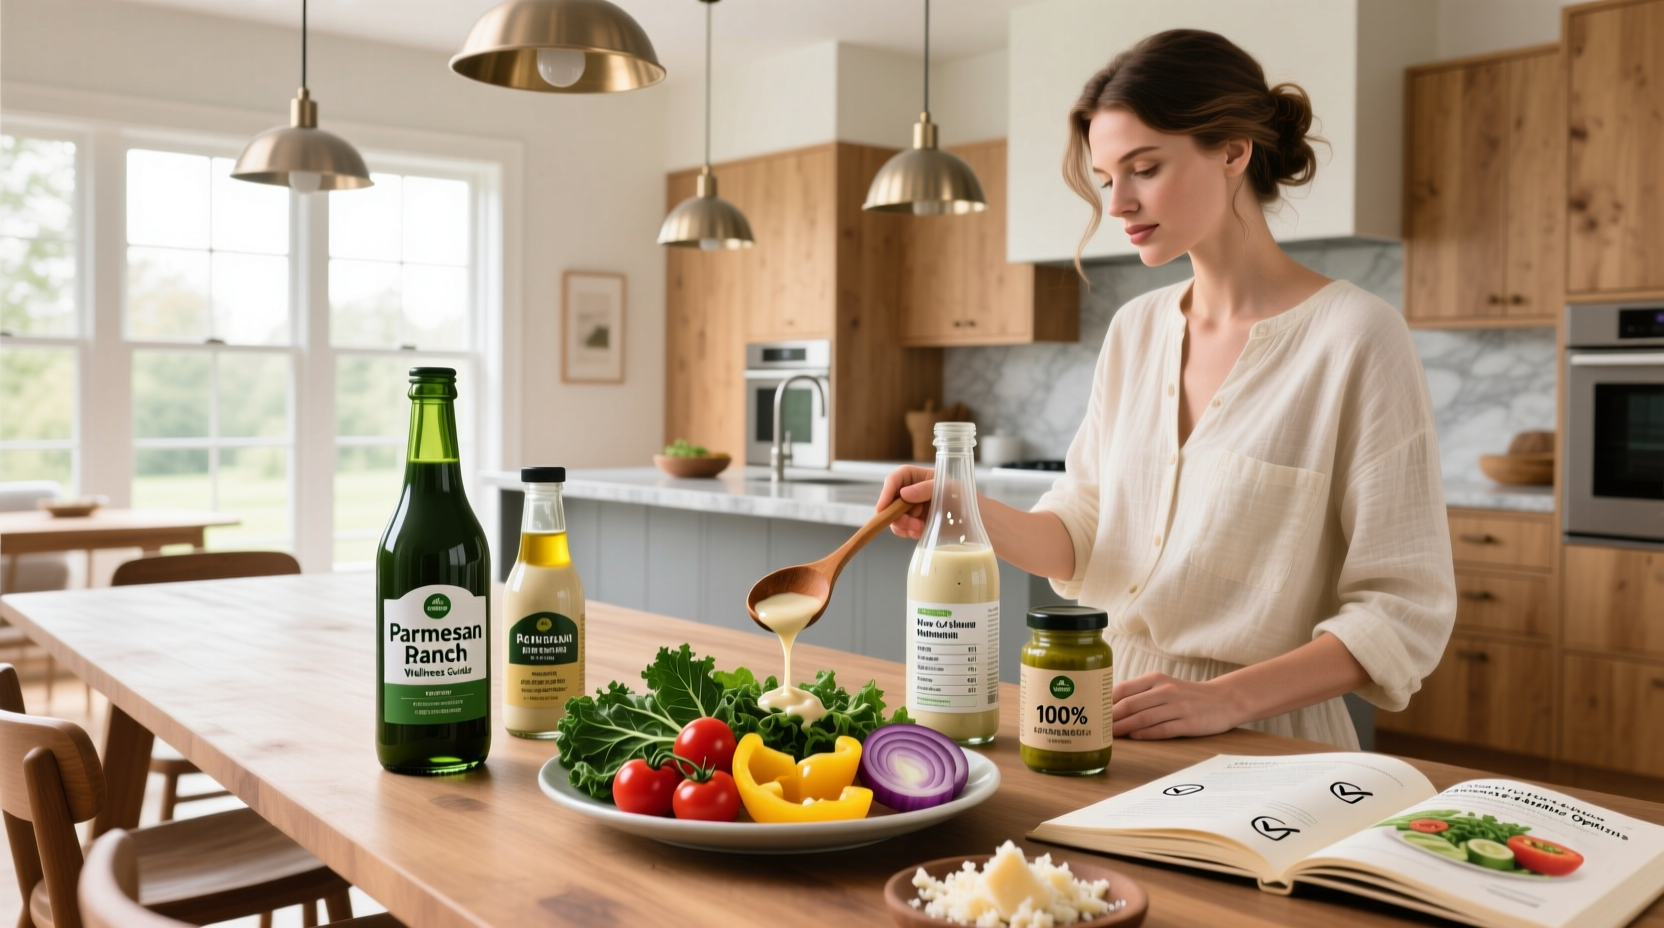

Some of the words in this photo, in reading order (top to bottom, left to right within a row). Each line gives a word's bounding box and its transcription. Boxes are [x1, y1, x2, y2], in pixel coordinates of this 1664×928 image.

[390, 623, 482, 642] Parmesan
[405, 643, 467, 664] Ranch
[1036, 705, 1088, 725] 100%
